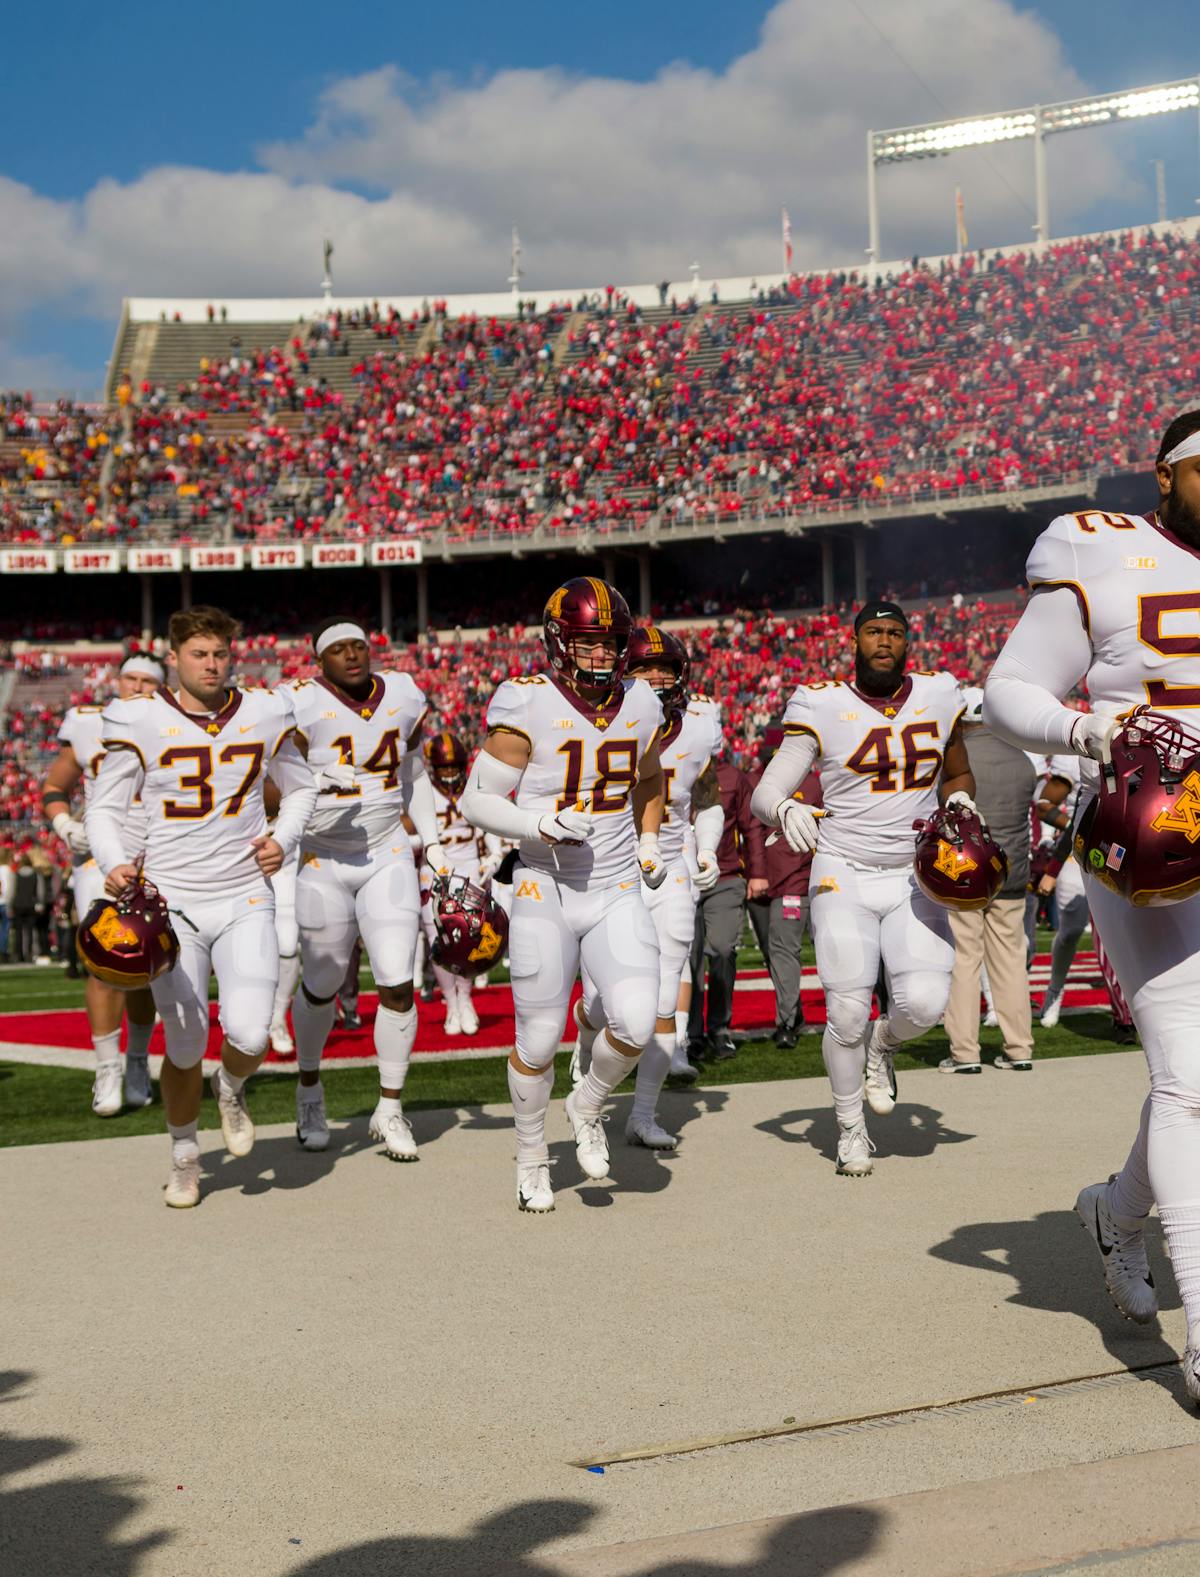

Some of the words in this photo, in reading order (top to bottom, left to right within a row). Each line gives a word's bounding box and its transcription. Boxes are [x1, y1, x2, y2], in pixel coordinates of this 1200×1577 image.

[377, 546, 416, 561] 2014
[159, 742, 265, 821] 37
[331, 728, 401, 798] 14
[555, 738, 640, 816] 18
[844, 721, 944, 794] 46
[516, 879, 544, 902] M
